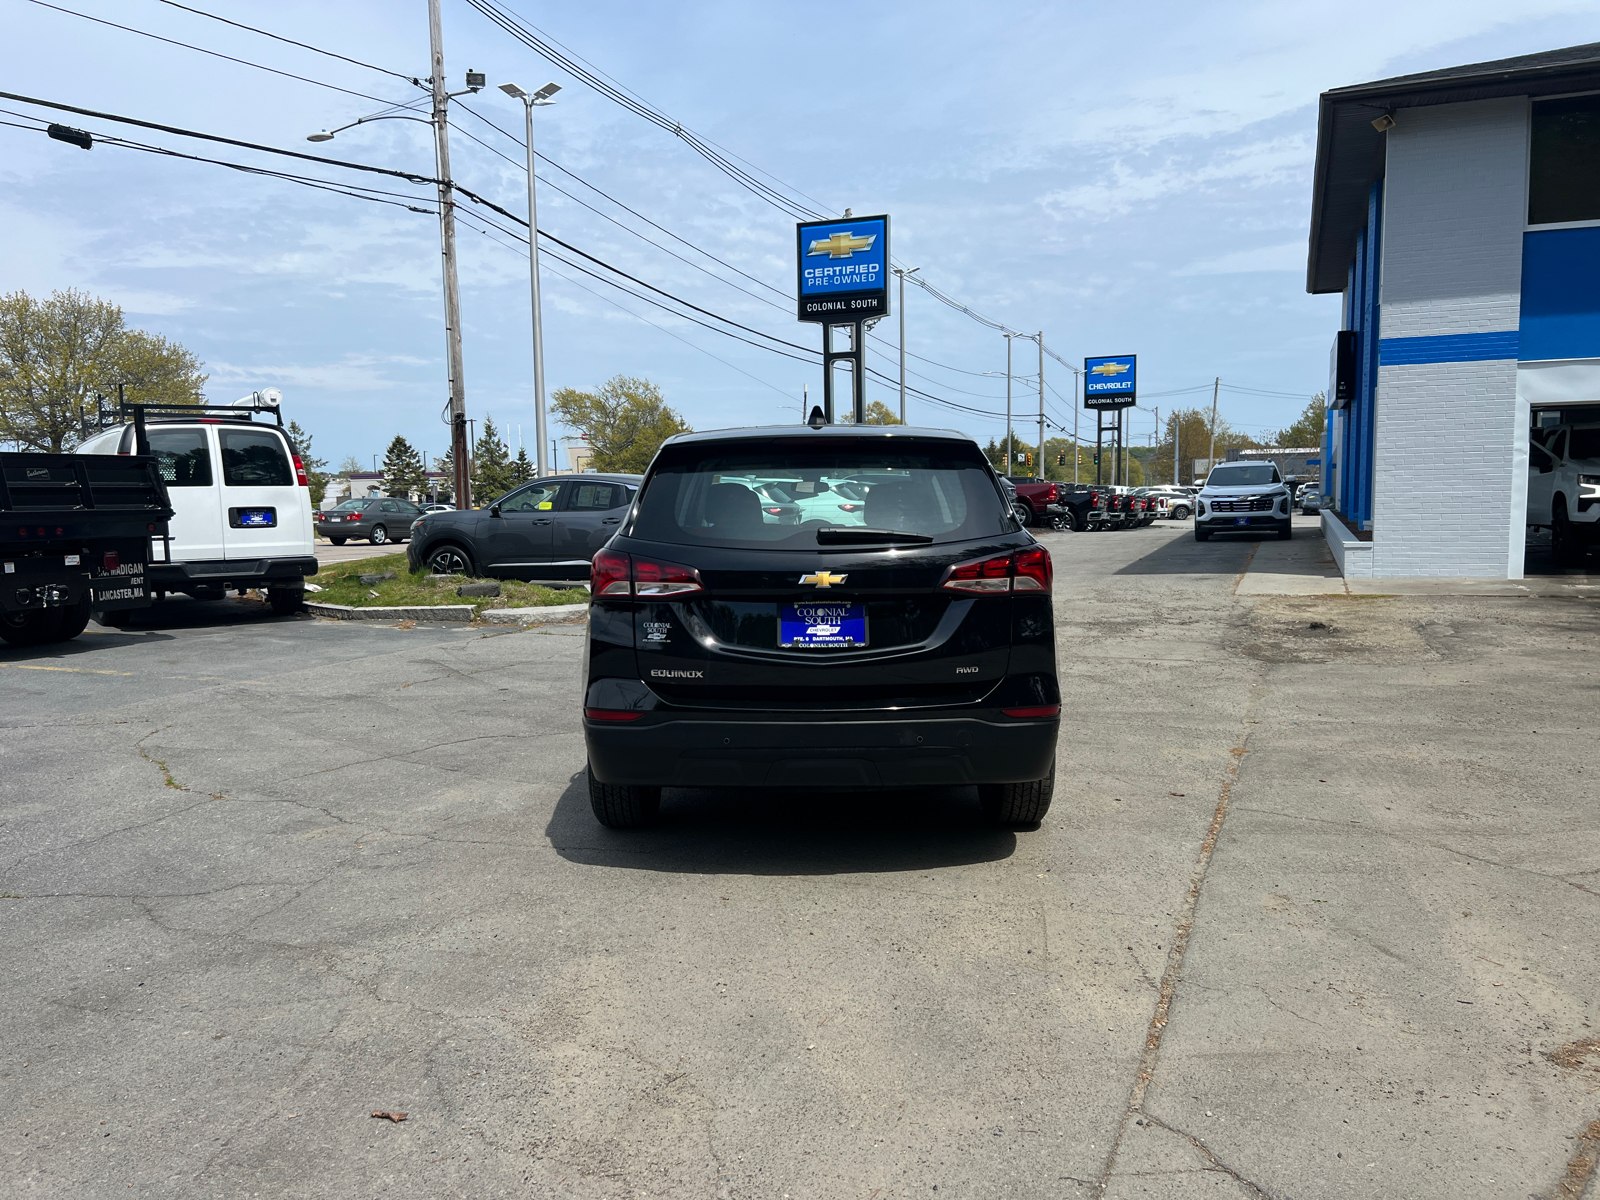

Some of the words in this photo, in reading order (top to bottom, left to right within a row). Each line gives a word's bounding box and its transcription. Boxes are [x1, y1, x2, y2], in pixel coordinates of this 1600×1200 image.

[804, 263, 880, 278] CERTIFIED
[808, 273, 876, 287] PRE-OWNED
[806, 301, 847, 312] COLONIAL
[850, 299, 878, 309] SOUTH
[1088, 381, 1132, 391] CHEVROLET
[796, 607, 850, 617] COLONIAL
[643, 621, 672, 629] COLONIAL
[804, 616, 842, 625] SOUTH
[650, 669, 704, 679] EQUINOX
[955, 666, 979, 674] AWD
